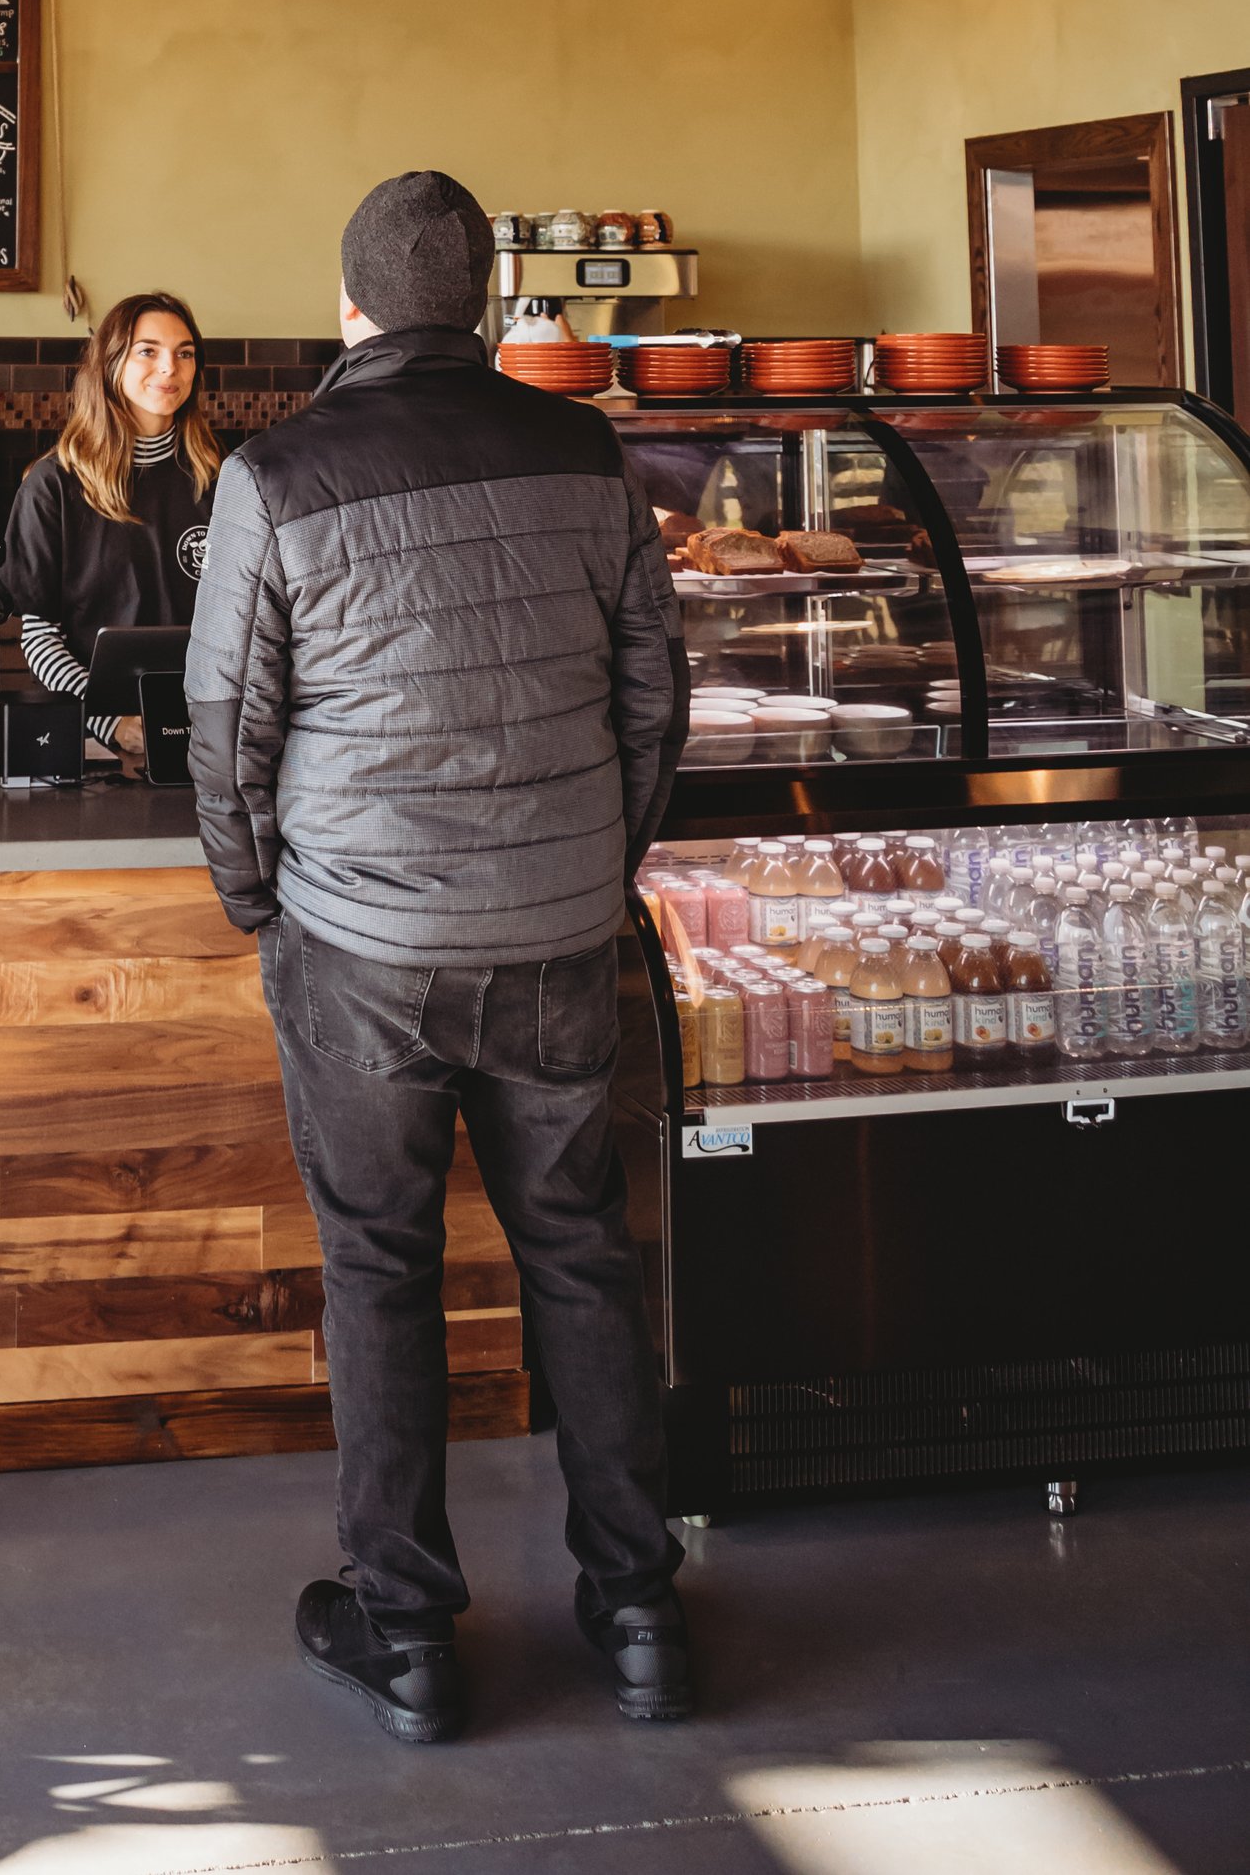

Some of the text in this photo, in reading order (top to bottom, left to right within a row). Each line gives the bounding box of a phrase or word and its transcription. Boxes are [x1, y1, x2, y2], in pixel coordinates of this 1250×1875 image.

[182, 533, 196, 551] DOWN
[162, 727, 184, 735] Down
[687, 1129, 750, 1153] AVANTCO
